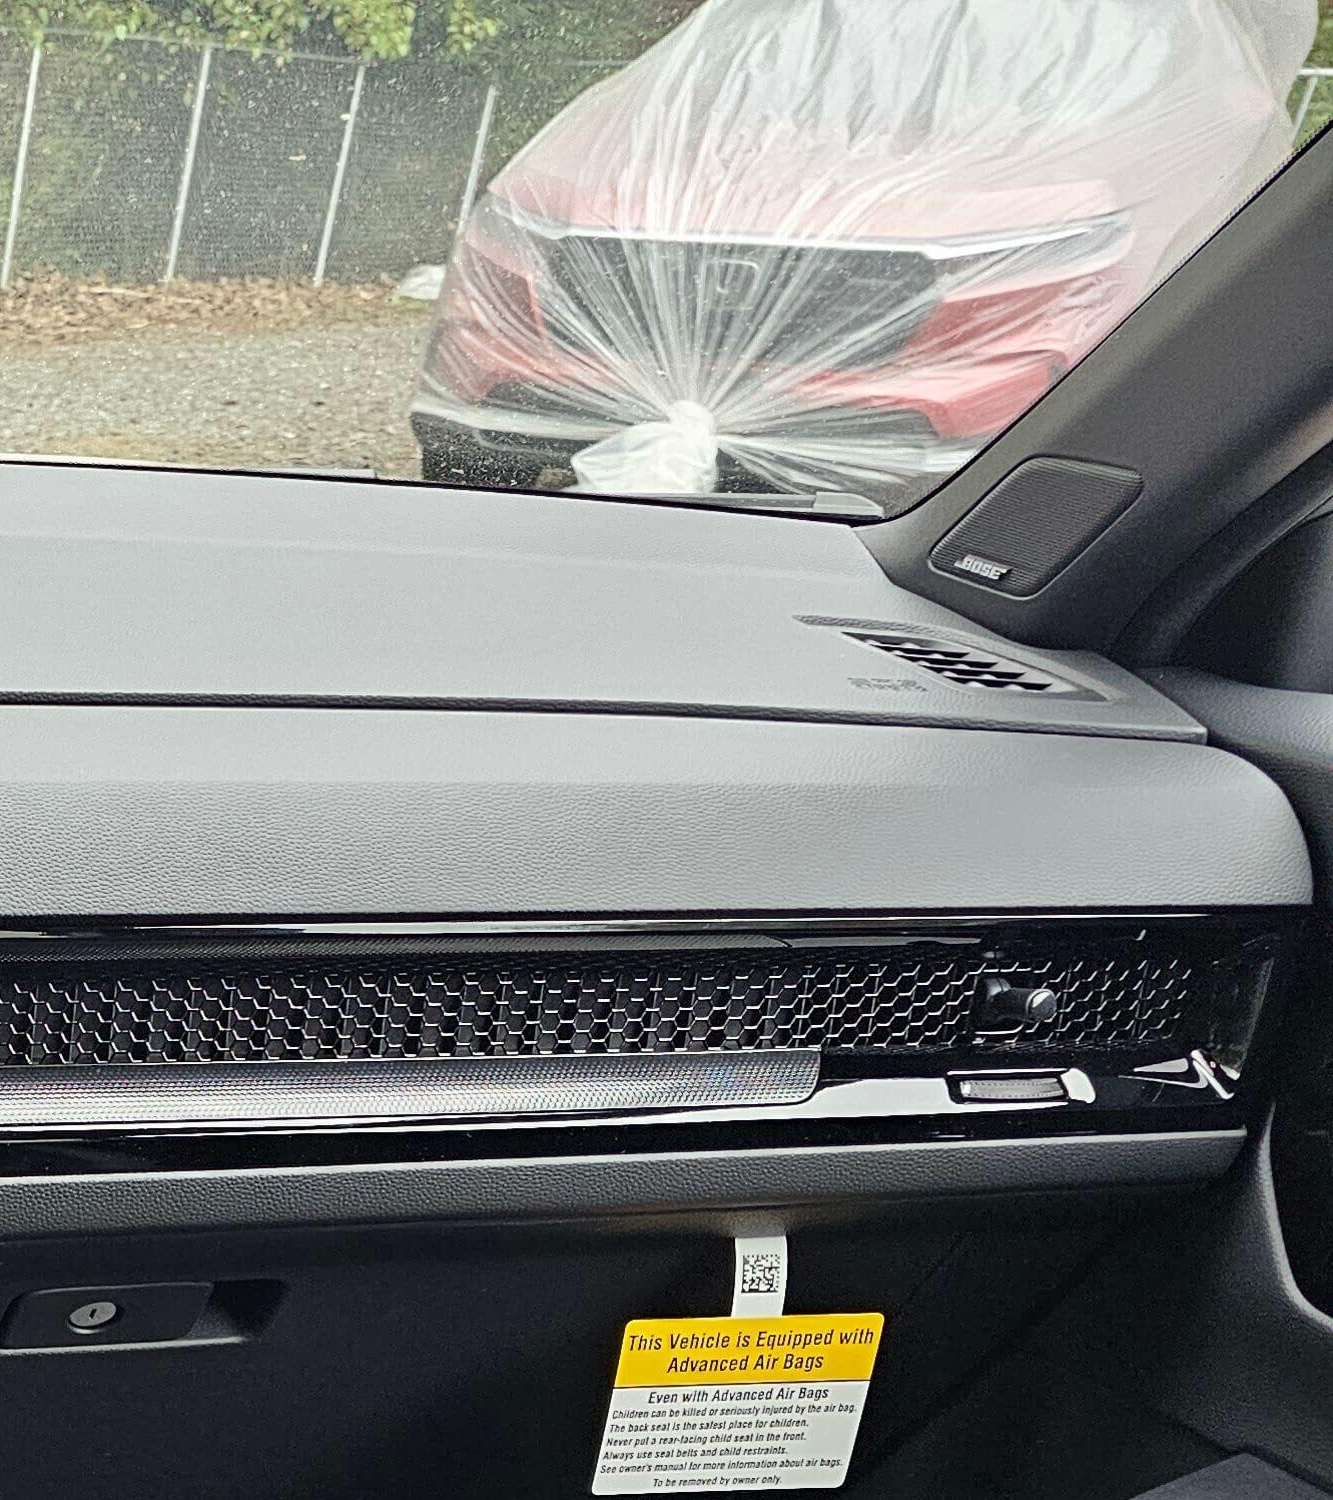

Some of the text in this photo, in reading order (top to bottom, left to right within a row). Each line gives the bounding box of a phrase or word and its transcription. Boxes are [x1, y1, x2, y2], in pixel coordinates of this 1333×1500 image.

[954, 554, 1013, 580] BOSE
[629, 1328, 874, 1351] This Vehicle is Equipped with
[667, 1354, 824, 1373] Advanced Air Bags
[647, 1387, 829, 1404] Even with Advanced Air Bags
[613, 1409, 648, 1419] Children
[651, 1410, 666, 1418] can
[669, 1408, 680, 1417] be
[682, 1408, 708, 1417] killed
[719, 1406, 760, 1415] seriously
[762, 1405, 793, 1416] injured
[795, 1405, 805, 1415] by
[808, 1404, 821, 1413] the
[823, 1404, 836, 1412] air
[838, 1403, 857, 1413] bag.
[609, 1419, 809, 1433] The back seat is the safest place for children.
[606, 1438, 632, 1446] Never
[634, 1437, 649, 1447] put
[658, 1435, 707, 1445] rear-facing
[710, 1434, 732, 1443] child
[734, 1433, 754, 1442] seat
[755, 1433, 764, 1441] in
[767, 1432, 781, 1441] the
[783, 1432, 807, 1440] front.
[602, 1446, 788, 1461] Always use seat belts and child restraints.
[600, 1458, 843, 1474] See owner's manual for more information about air bags.
[653, 1475, 782, 1487] To be removed by owner only.
